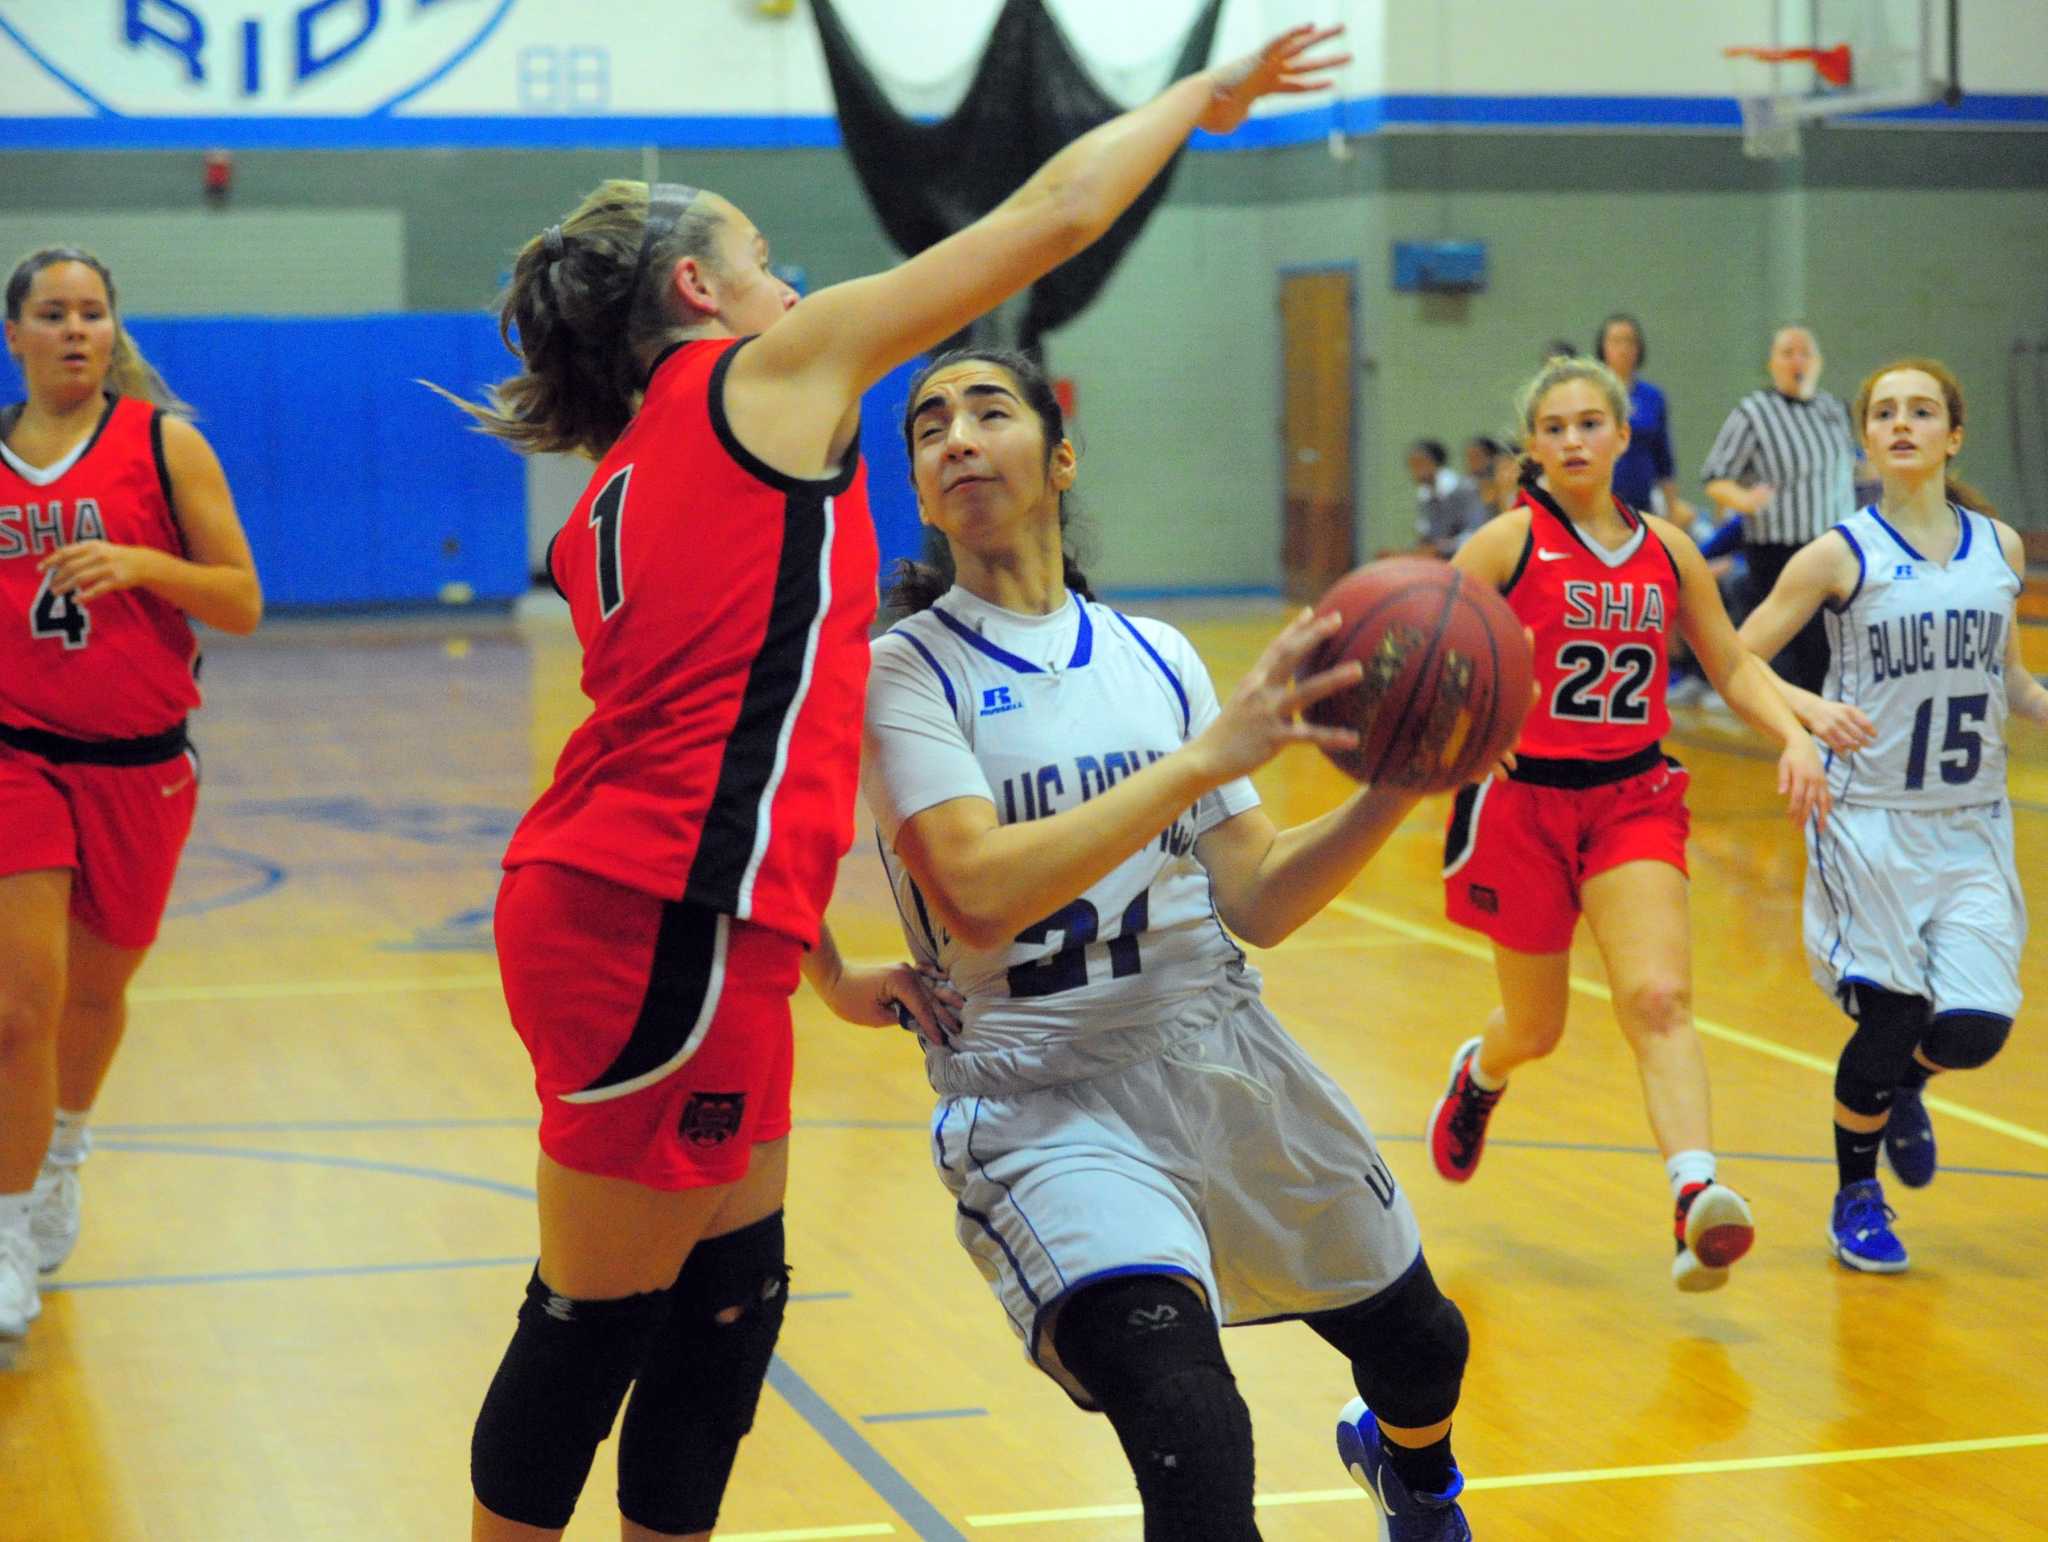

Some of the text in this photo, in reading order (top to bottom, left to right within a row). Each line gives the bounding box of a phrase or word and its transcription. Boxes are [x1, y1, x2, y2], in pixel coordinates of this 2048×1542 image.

[0, 498, 107, 559] SHA
[588, 463, 634, 622] 1
[29, 566, 91, 650] 4
[1563, 580, 1664, 633] SHA
[1868, 611, 1935, 683] BLUE
[1551, 640, 1656, 724] 22
[1904, 693, 1989, 791] 15
